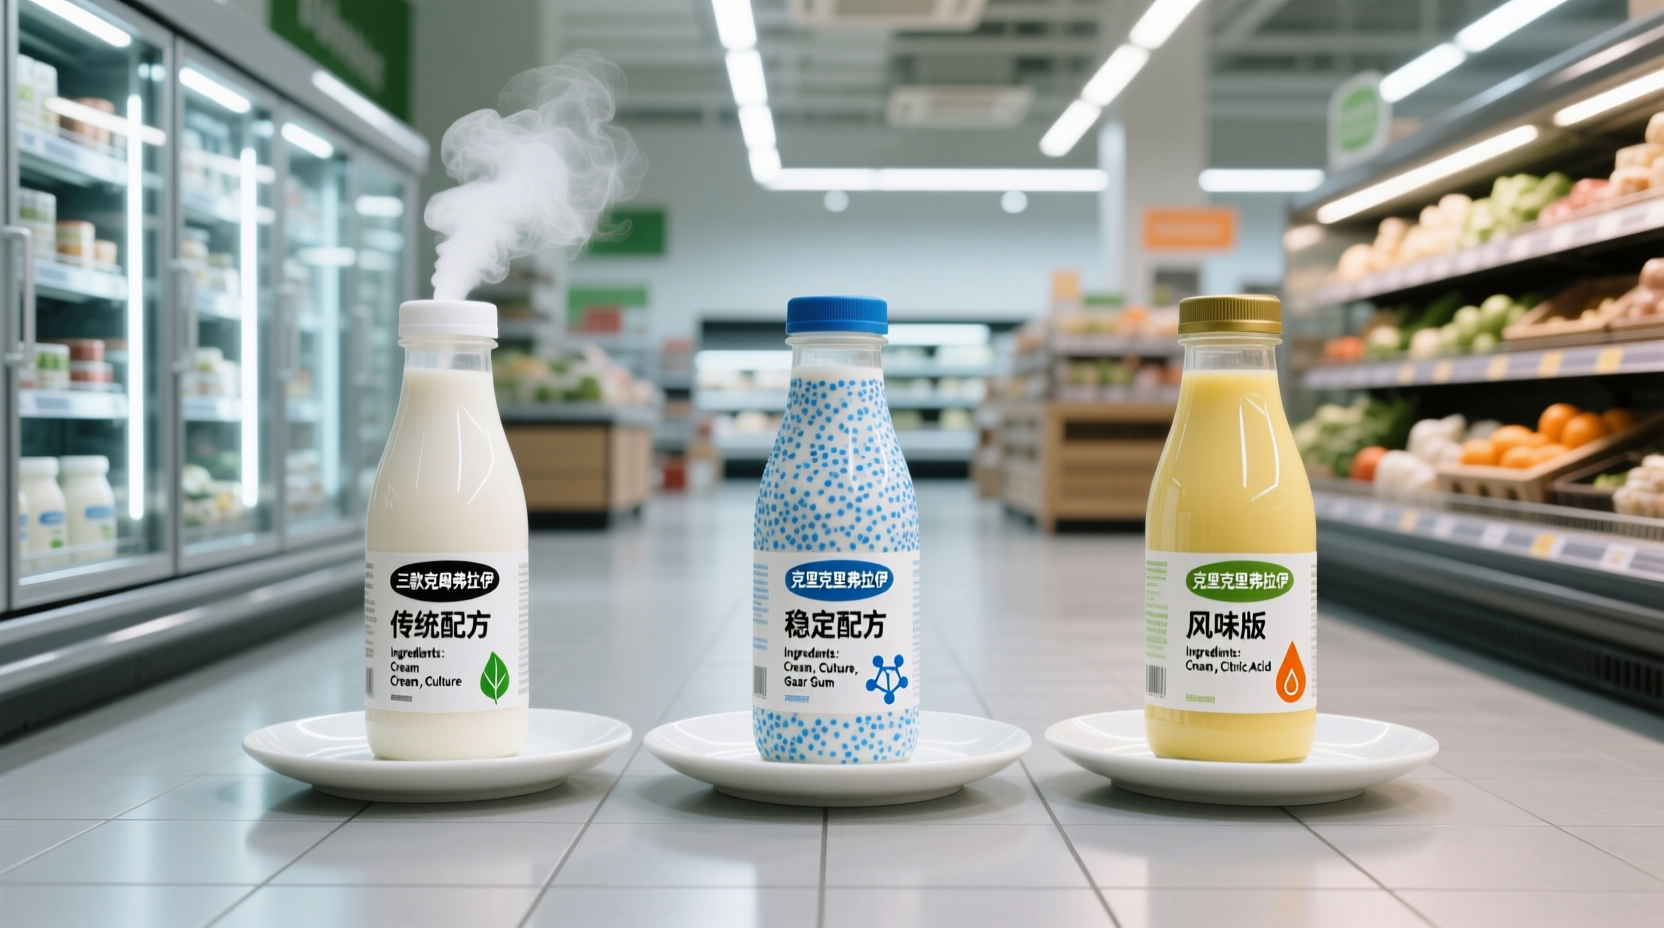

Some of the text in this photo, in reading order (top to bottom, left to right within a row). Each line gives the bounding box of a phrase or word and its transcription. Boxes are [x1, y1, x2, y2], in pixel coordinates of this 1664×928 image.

[390, 610, 491, 639] 传统配方
[784, 609, 887, 640] 稳定配方
[1186, 610, 1266, 640] 风味版
[425, 675, 463, 687] Culture
